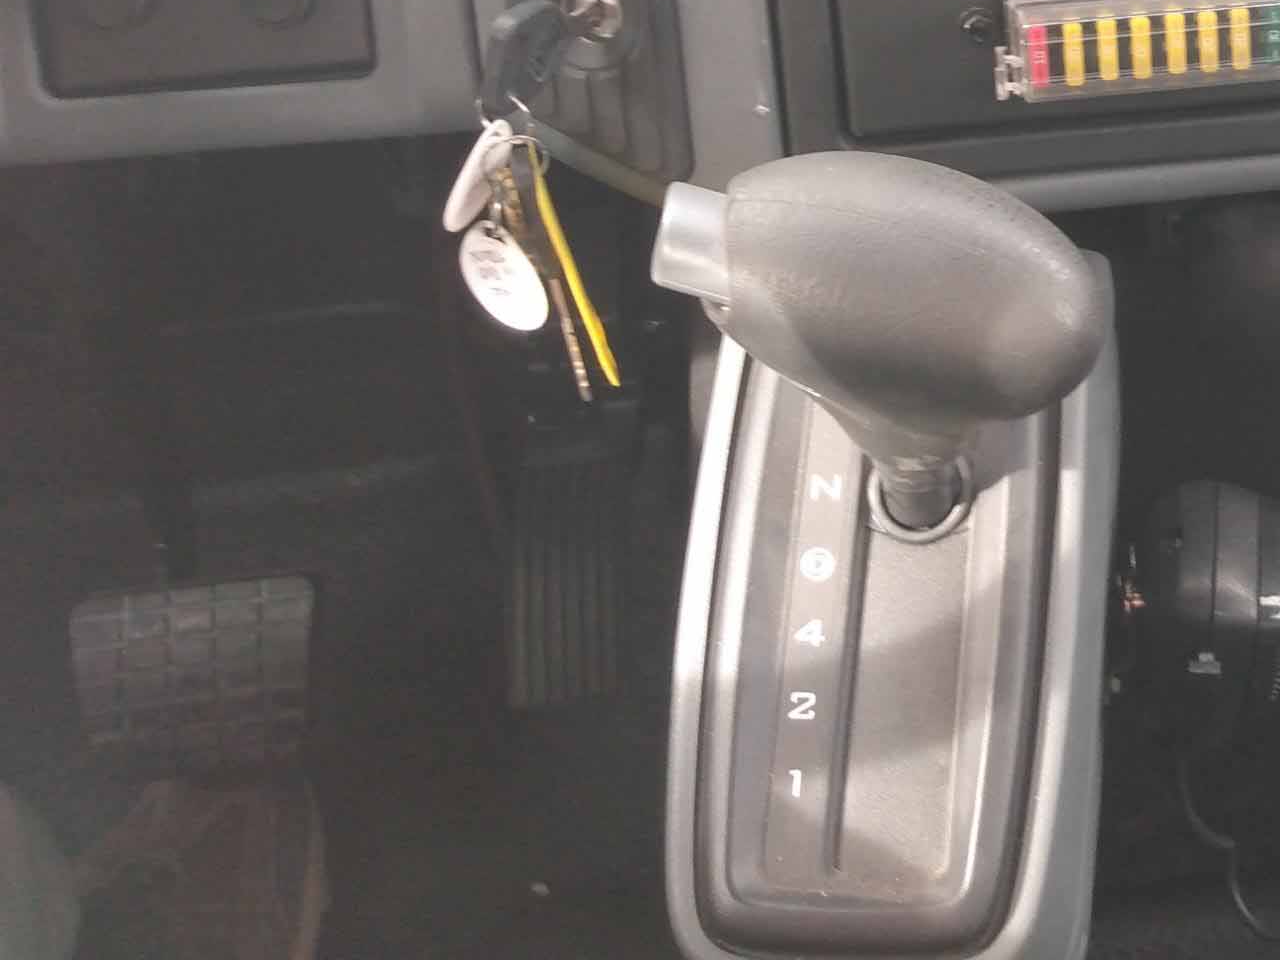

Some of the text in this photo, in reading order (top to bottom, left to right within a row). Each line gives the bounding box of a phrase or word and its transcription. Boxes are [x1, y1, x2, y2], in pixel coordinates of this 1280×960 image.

[809, 473, 843, 501] N
[793, 618, 827, 648] 4
[787, 692, 817, 721] 2
[788, 769, 802, 798] 1
